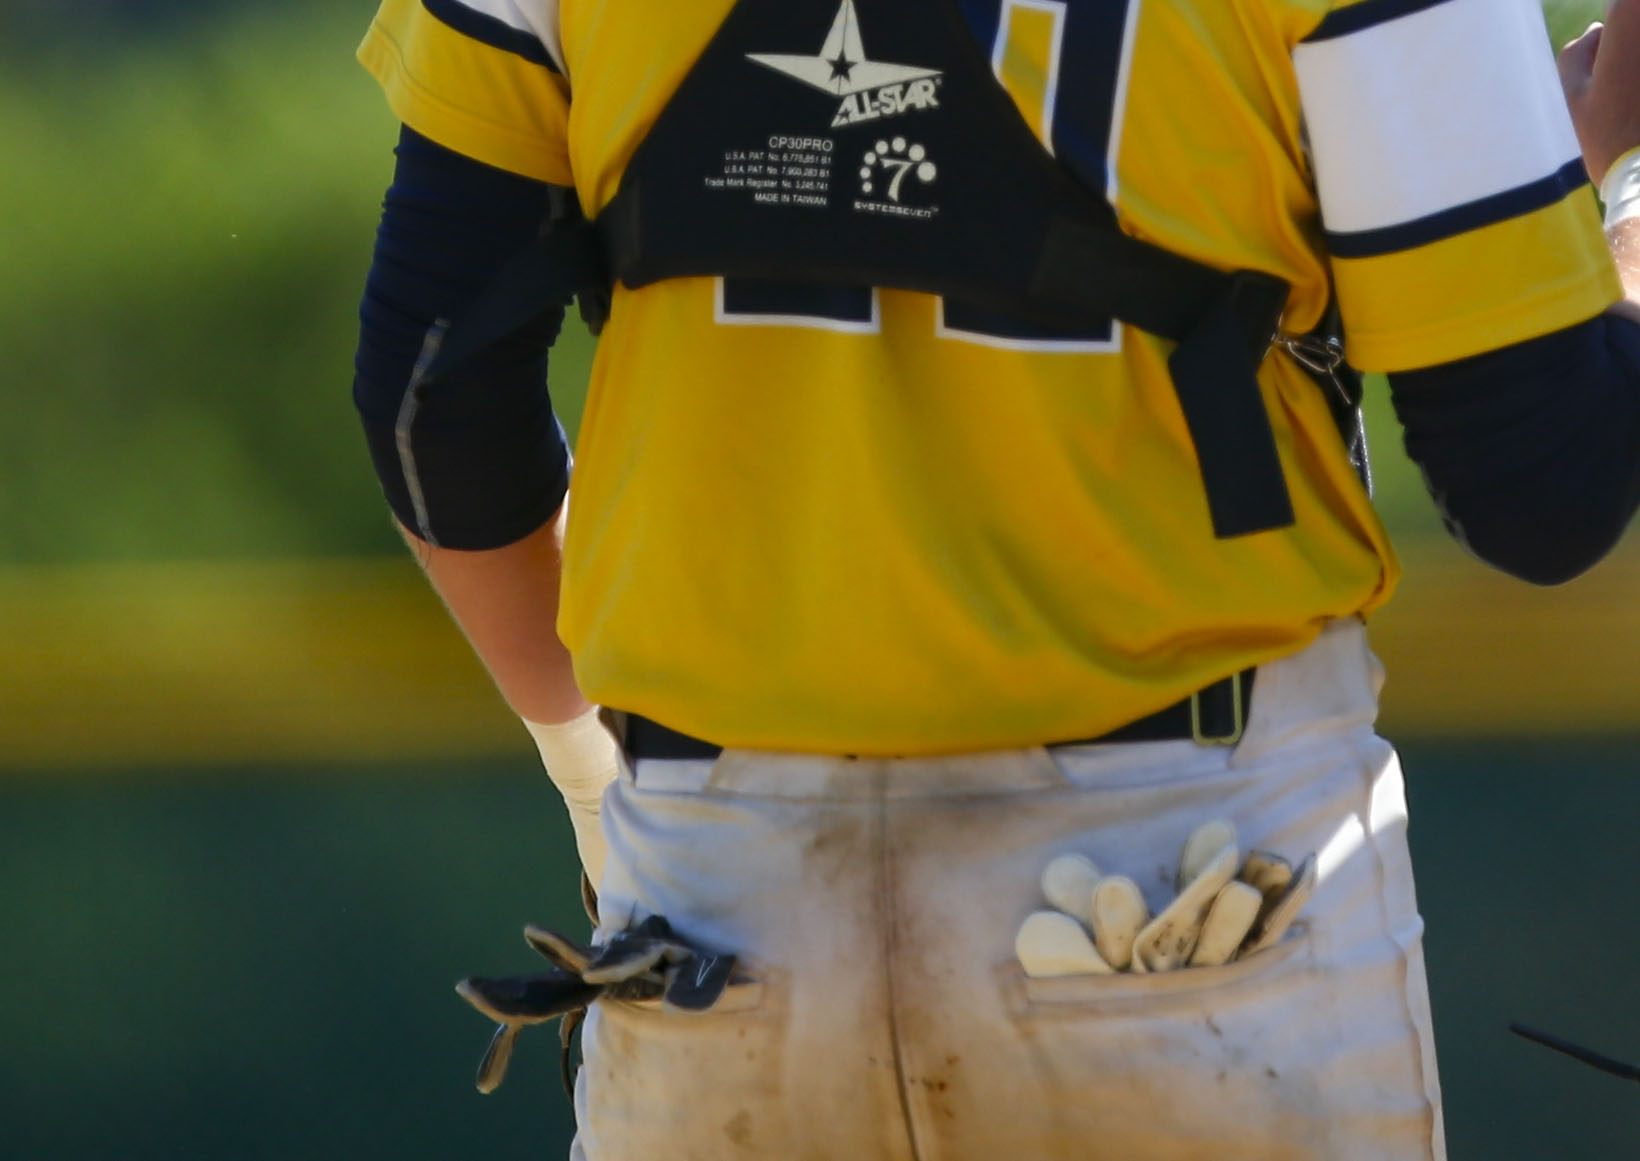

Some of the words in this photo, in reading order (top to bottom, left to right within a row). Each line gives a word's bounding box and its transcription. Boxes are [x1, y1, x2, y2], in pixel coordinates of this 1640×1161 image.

[831, 78, 940, 127] ALL-STAR
[769, 136, 833, 152] CP30PRO
[754, 193, 779, 203] MADE
[781, 193, 790, 203] IN
[793, 194, 827, 205] TAIWAN
